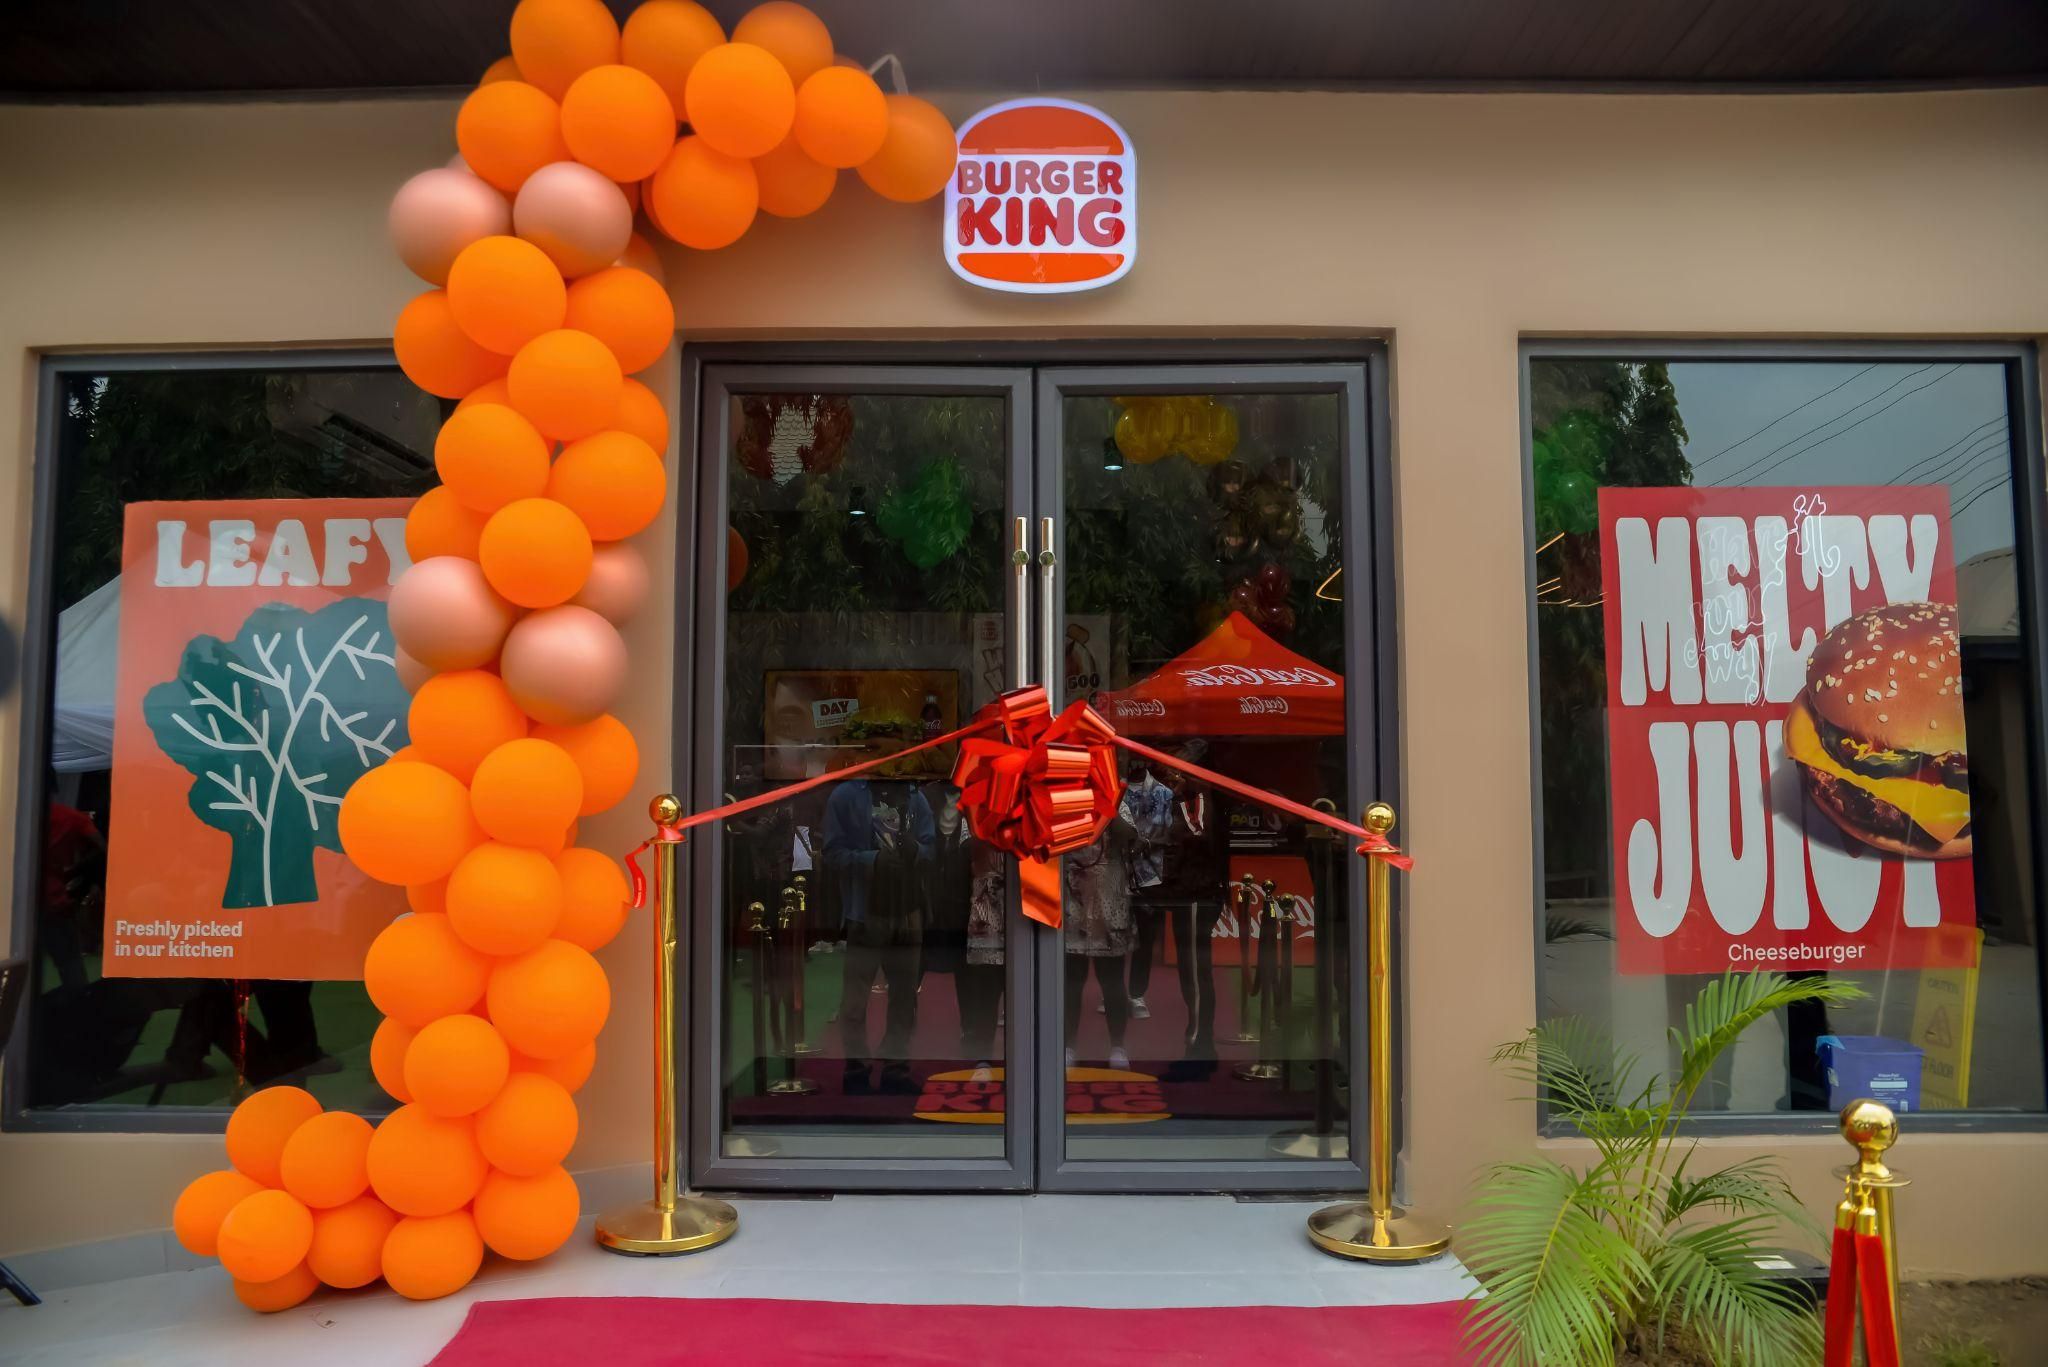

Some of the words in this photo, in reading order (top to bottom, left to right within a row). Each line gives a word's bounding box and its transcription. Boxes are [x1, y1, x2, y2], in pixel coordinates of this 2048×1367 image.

[957, 160, 1124, 195] BURGER
[957, 196, 1126, 247] KING
[820, 700, 849, 716] DAY
[116, 920, 181, 940] Freshly
[184, 920, 243, 940] picked
[115, 940, 131, 956] in
[134, 944, 165, 957] our
[168, 940, 234, 957] kitchen
[1727, 942, 1867, 964] Cheeseburger
